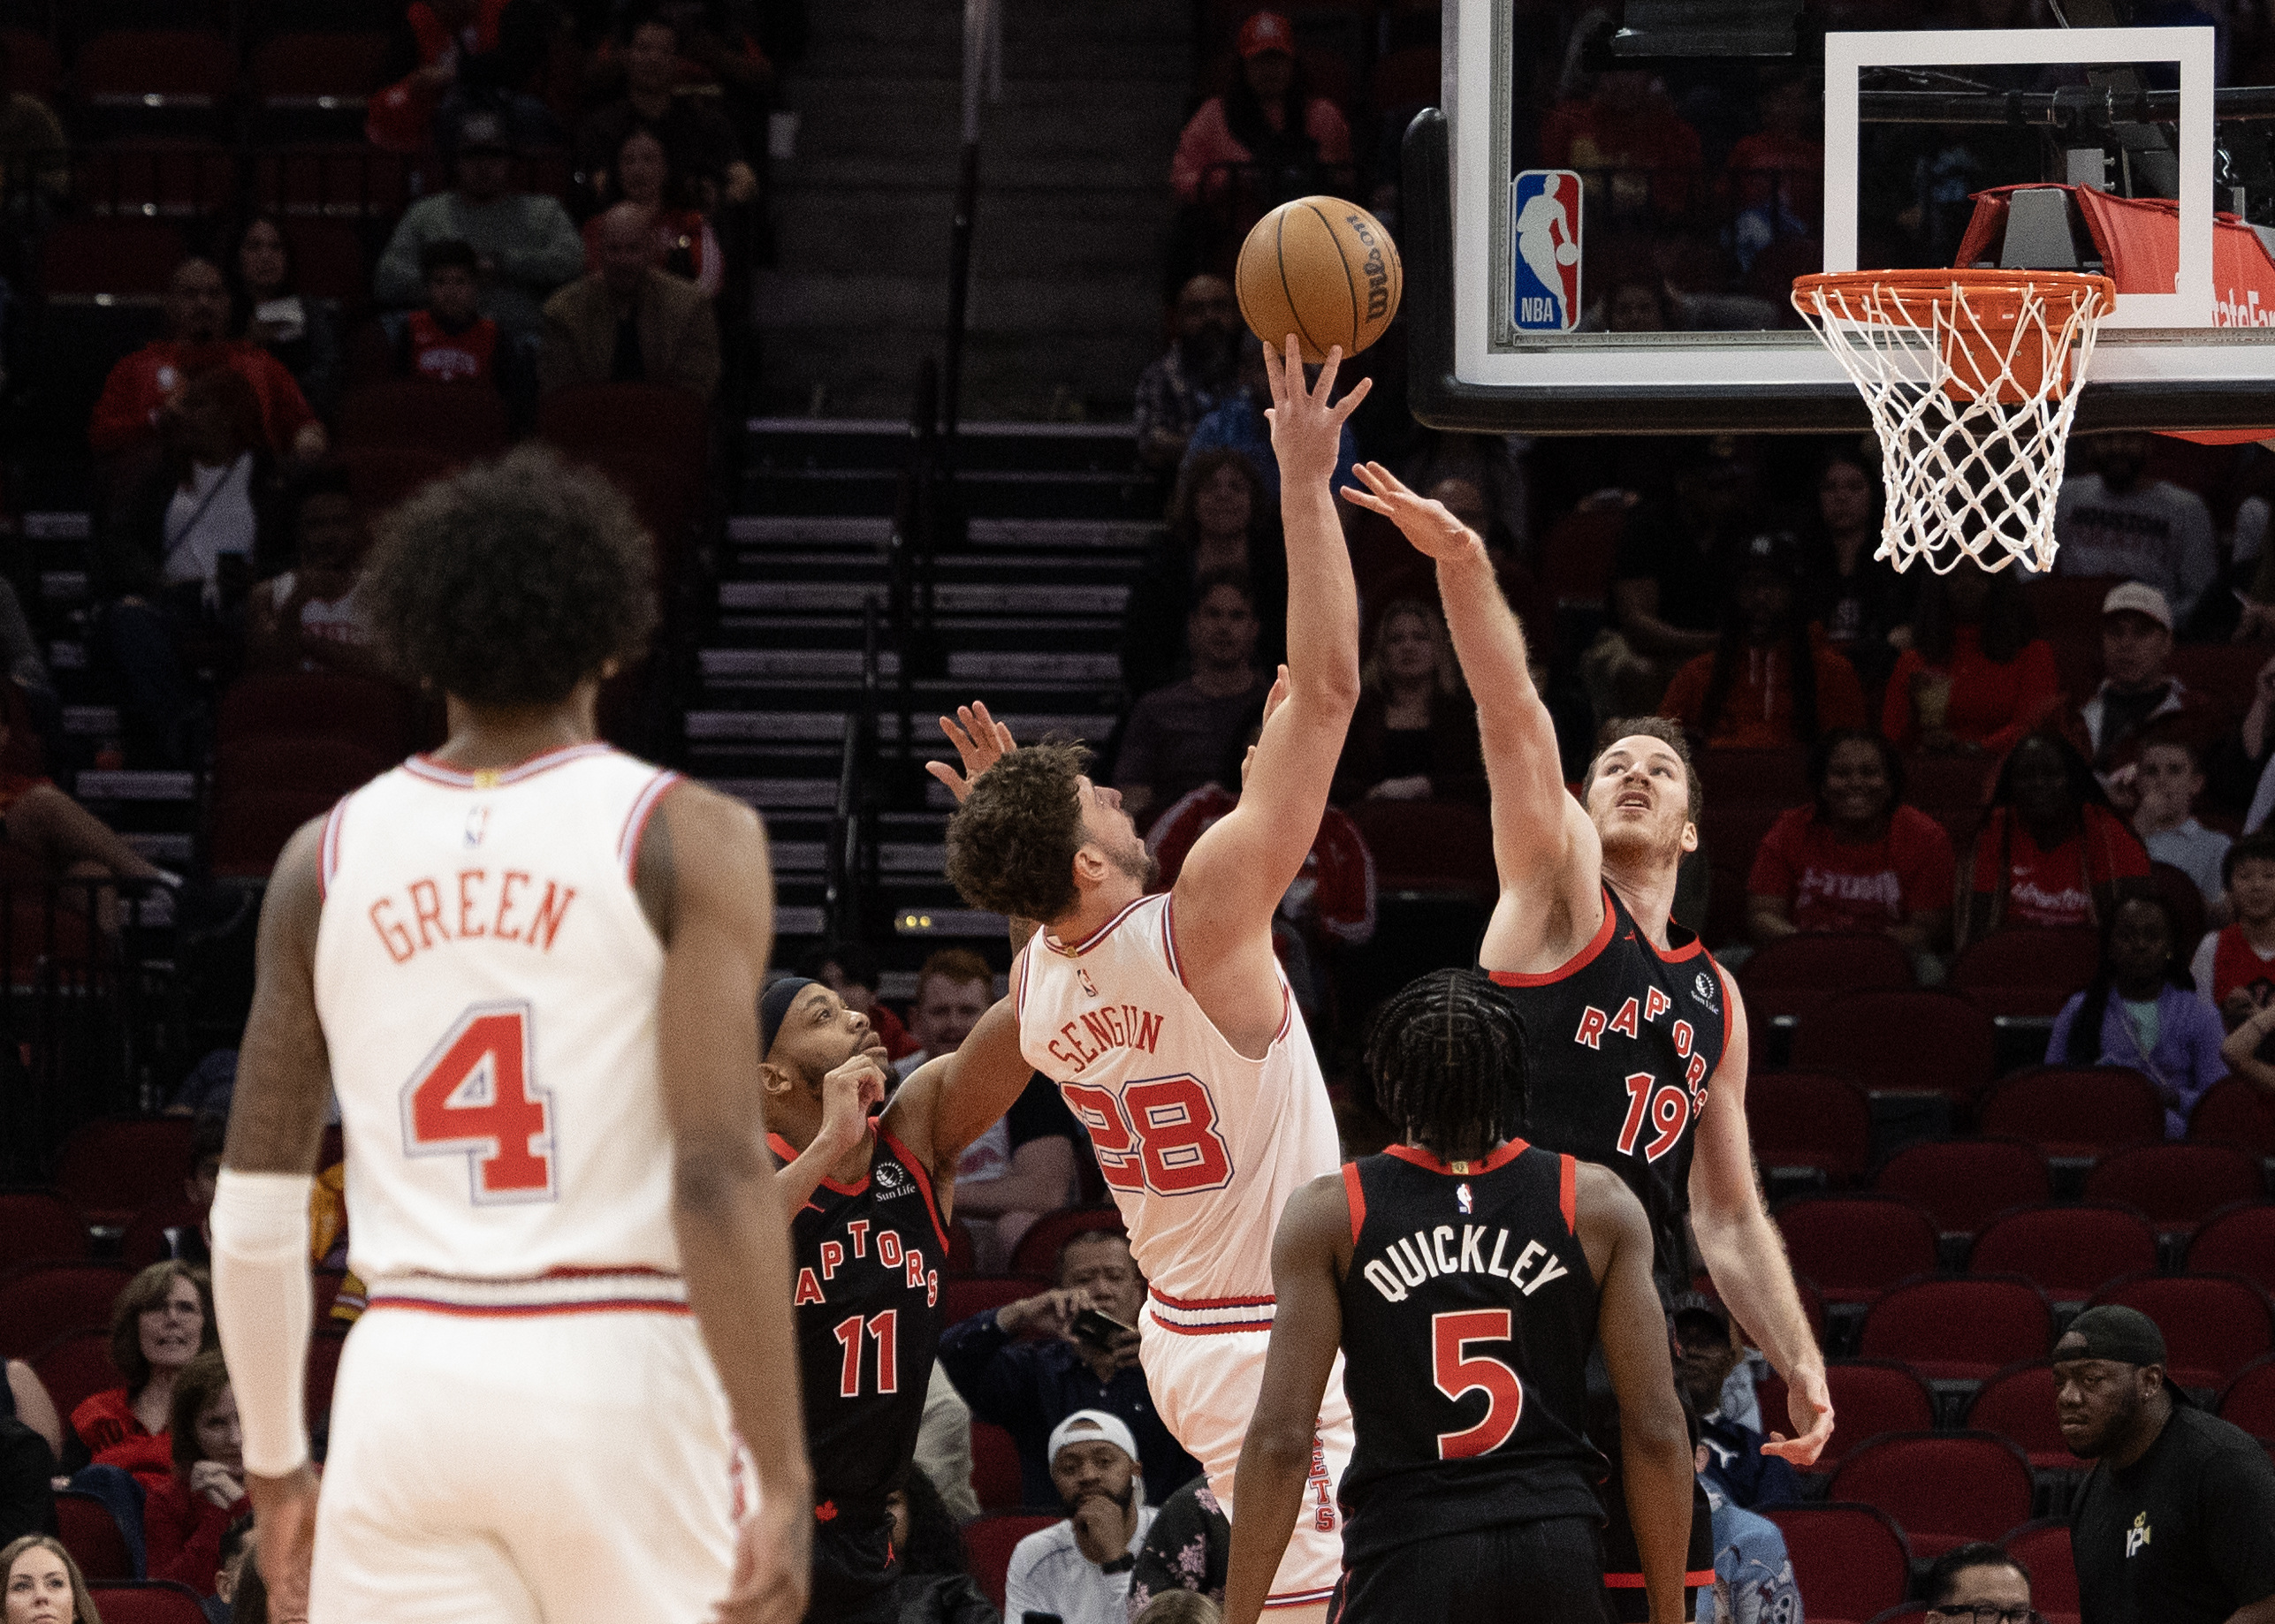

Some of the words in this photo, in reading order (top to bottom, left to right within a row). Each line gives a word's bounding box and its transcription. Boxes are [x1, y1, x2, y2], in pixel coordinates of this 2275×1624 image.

[1345, 214, 1389, 324] Wilson
[1521, 296, 1554, 323] NBA
[368, 867, 579, 966] GREEN
[1047, 1004, 1165, 1074] SENGUN
[1574, 984, 1708, 1120] RAPORS
[398, 997, 559, 1208] 4
[1058, 1072, 1236, 1198] 28
[1617, 1071, 1690, 1164] 19
[875, 1192, 896, 1203] Sun
[896, 1183, 916, 1197] Life
[795, 1218, 939, 1309] APTORS
[1364, 1224, 1569, 1303] QUICKLEY
[833, 1309, 898, 1398] 11
[1431, 1308, 1524, 1461] 5
